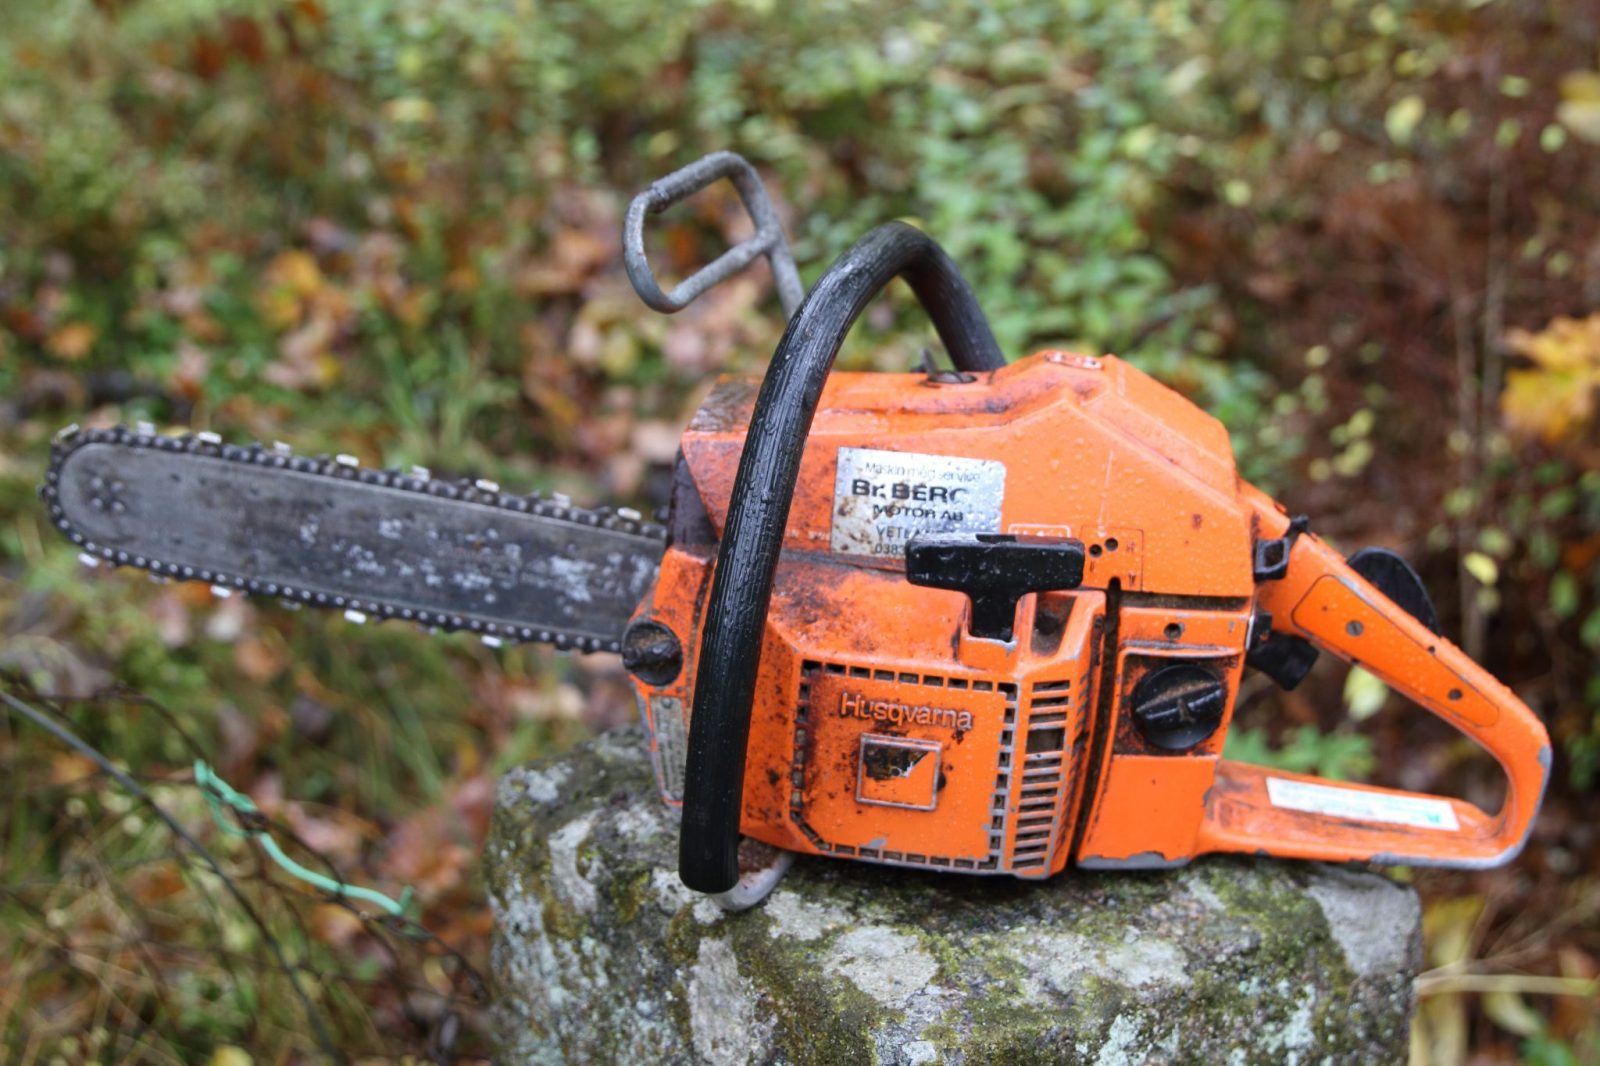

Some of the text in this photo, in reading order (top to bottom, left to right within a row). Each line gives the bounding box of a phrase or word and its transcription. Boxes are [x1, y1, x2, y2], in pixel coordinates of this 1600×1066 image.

[873, 504, 964, 521] MOTOR AB
[840, 692, 973, 730] Husqvarna
